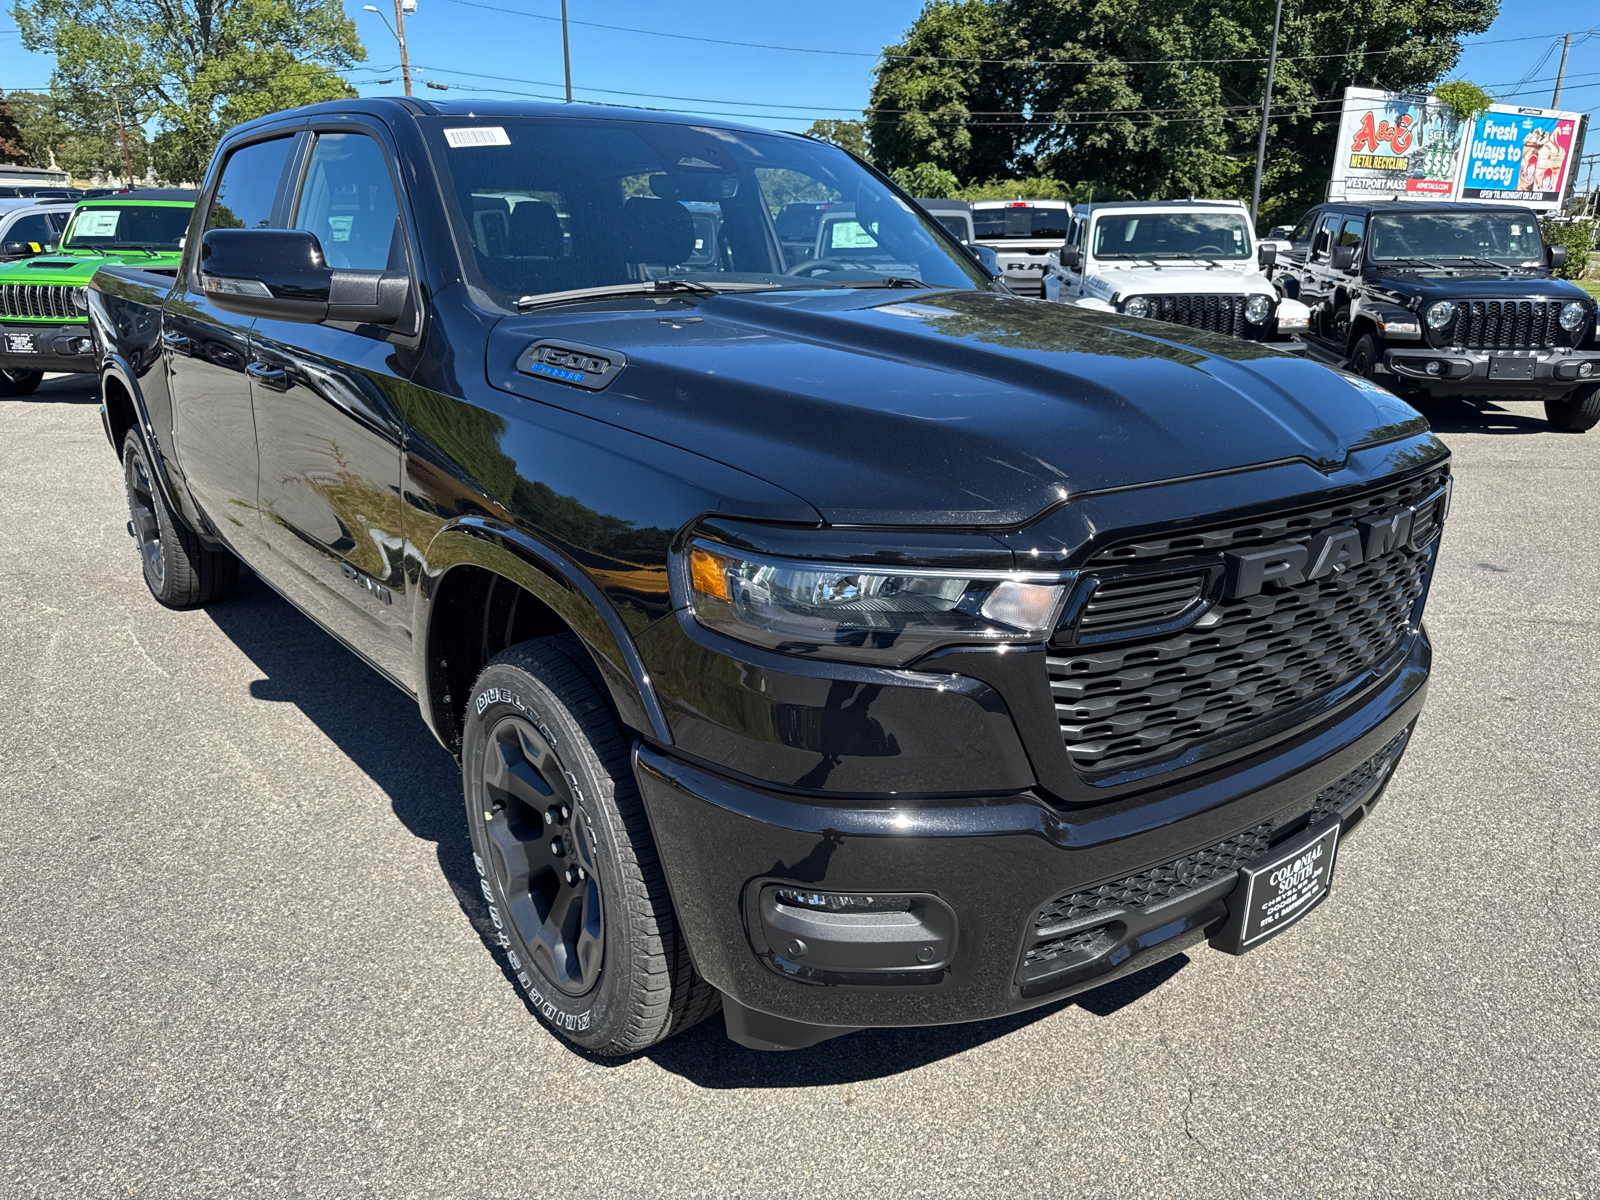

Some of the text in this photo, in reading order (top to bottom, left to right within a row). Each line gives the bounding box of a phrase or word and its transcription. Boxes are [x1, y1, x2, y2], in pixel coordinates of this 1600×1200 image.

[1351, 111, 1413, 155] A&E
[1483, 120, 1518, 142] Fresh
[1350, 155, 1408, 170] METAL RECYCLING
[1472, 139, 1521, 165] Ways to
[1345, 178, 1407, 191] WESTPORT MASS
[1472, 160, 1514, 186] Frosty
[1416, 182, 1449, 191] AEMETALS.COM
[1480, 190, 1493, 199] OPEN
[1501, 191, 1523, 200] MIDNIGHT
[1529, 192, 1543, 200] LATER
[1007, 263, 1044, 271] RA
[529, 347, 611, 375] 1500
[1226, 506, 1413, 599] RAM
[476, 687, 557, 749] DUELER
[1269, 844, 1323, 886] COLONIAL
[1278, 862, 1314, 895] SOUTH
[1261, 879, 1308, 910] CHRYSLER
[1266, 893, 1298, 916] DODGE
